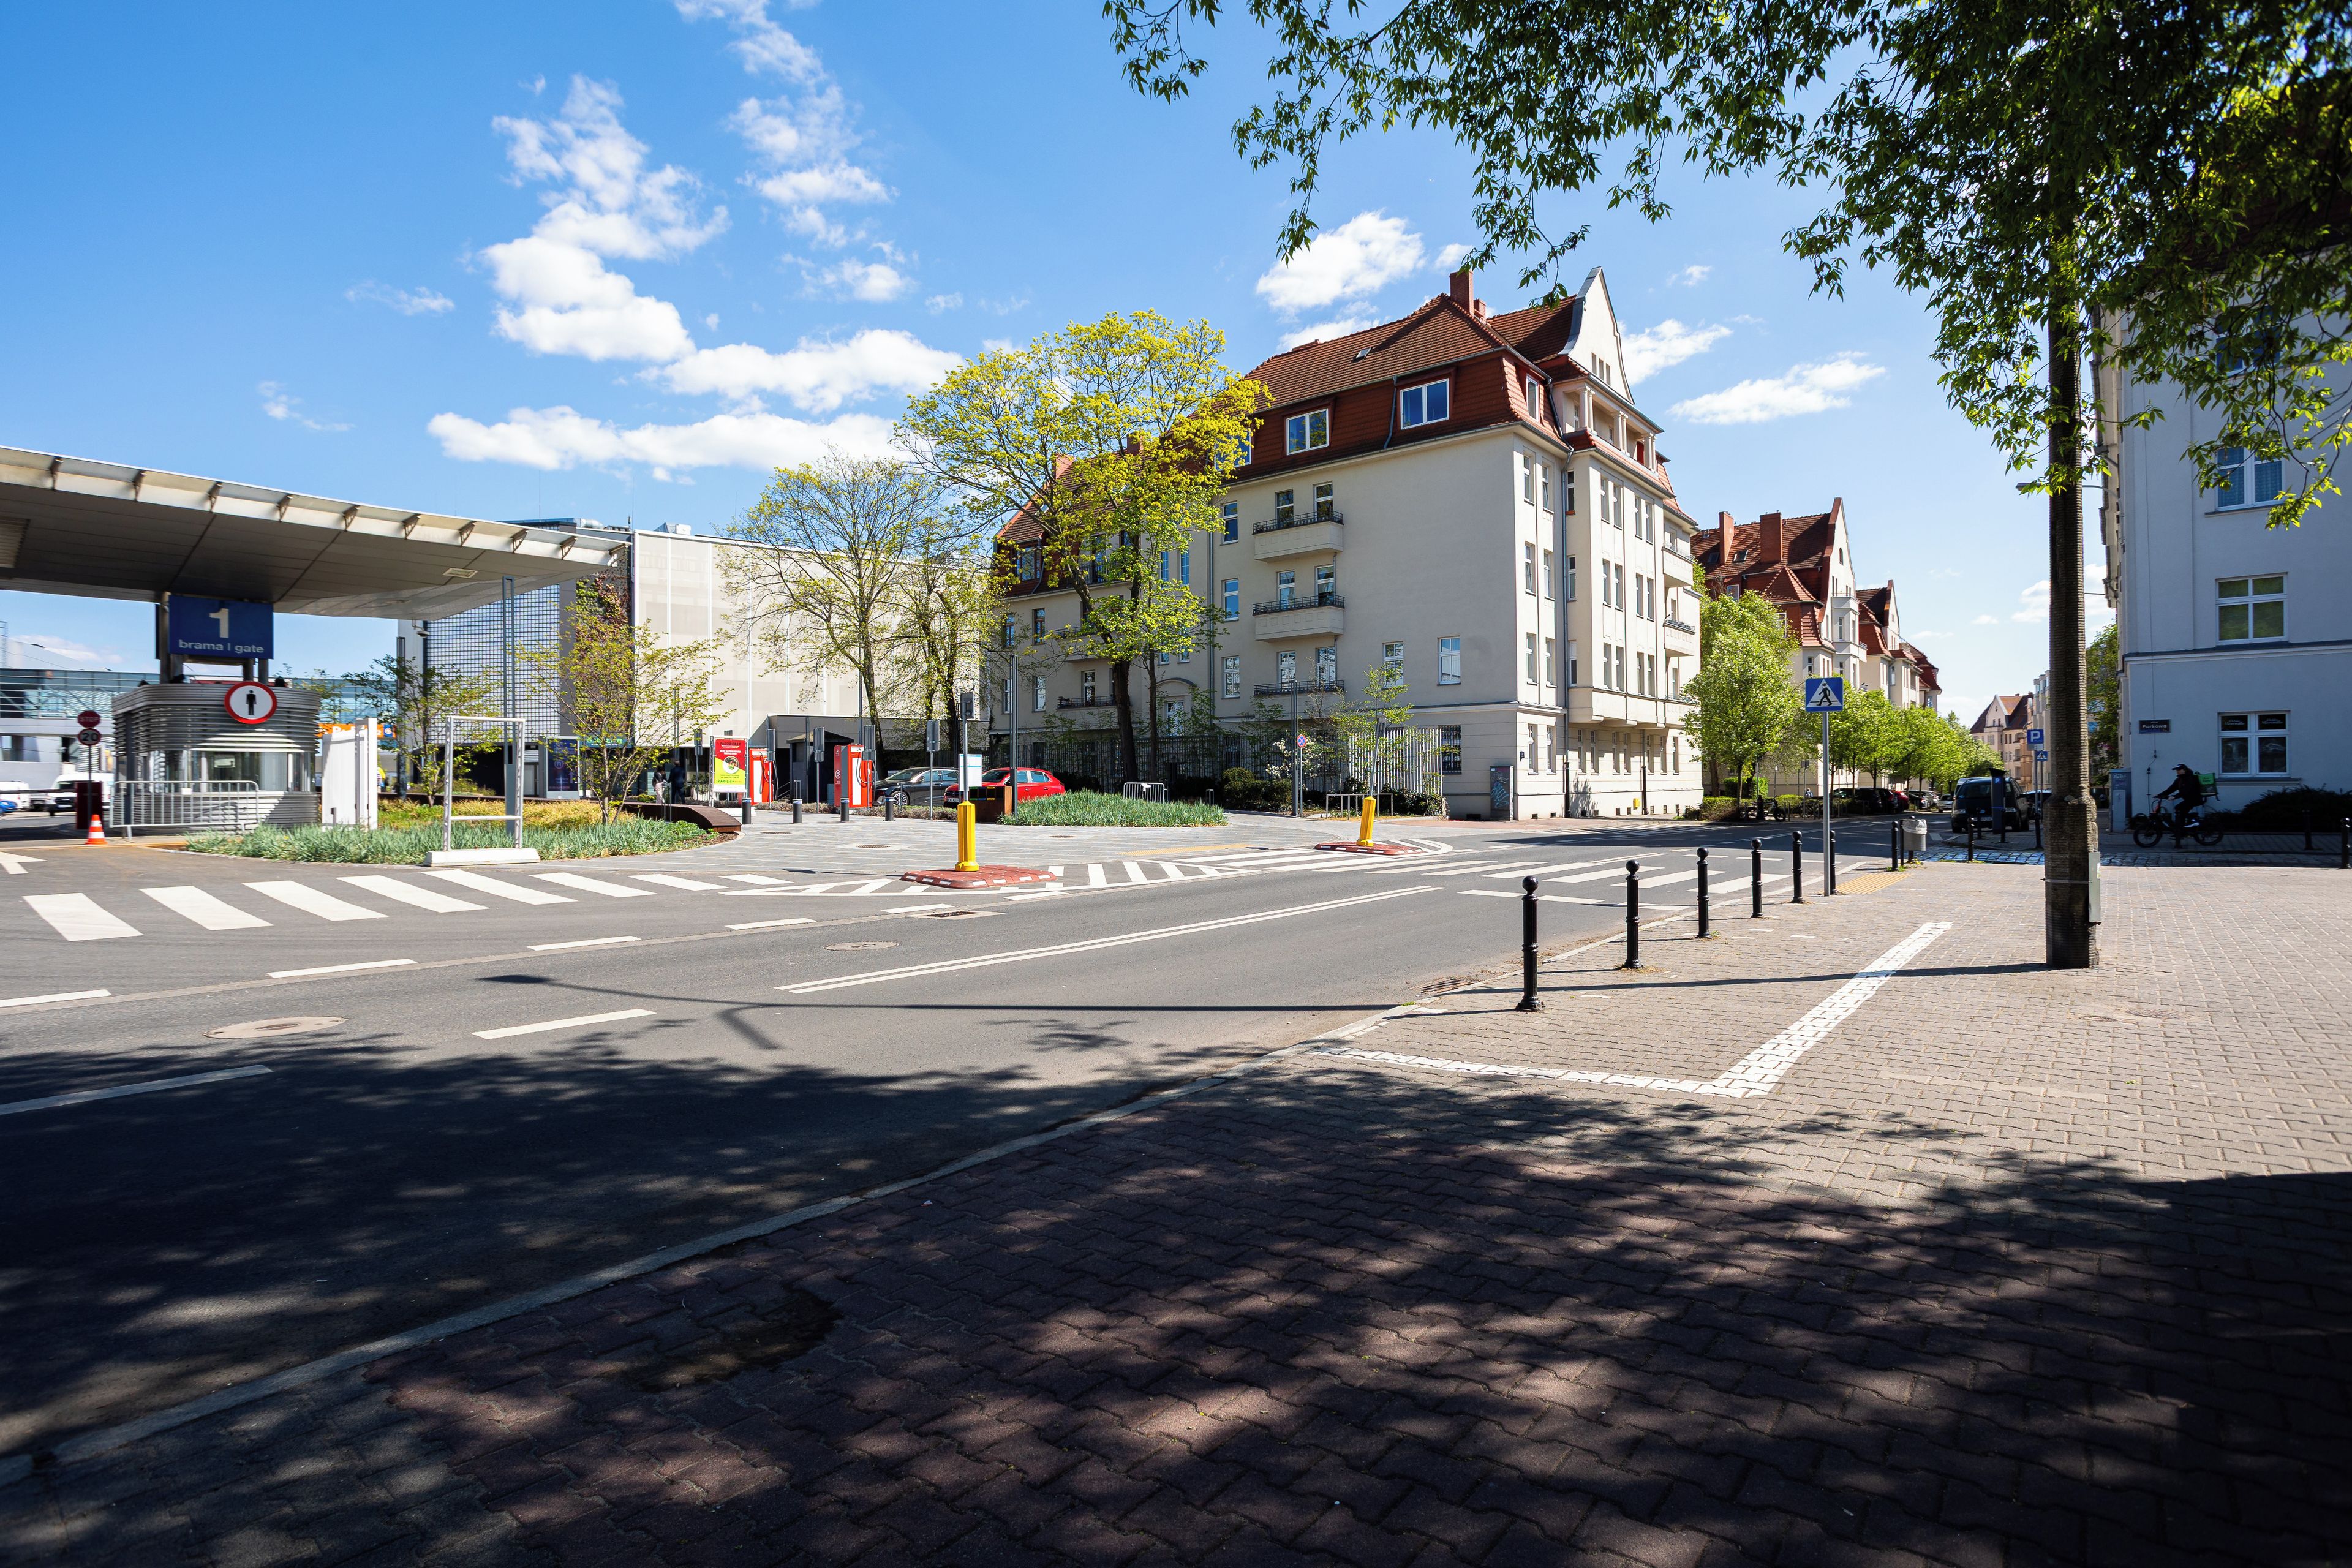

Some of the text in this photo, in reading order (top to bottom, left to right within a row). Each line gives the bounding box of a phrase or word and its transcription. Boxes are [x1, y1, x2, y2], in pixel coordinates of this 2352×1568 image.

[209, 608, 229, 638] 1
[179, 639, 223, 650] brama
[235, 644, 264, 654] gate
[82, 733, 99, 741] 20
[2030, 731, 2040, 742] P
